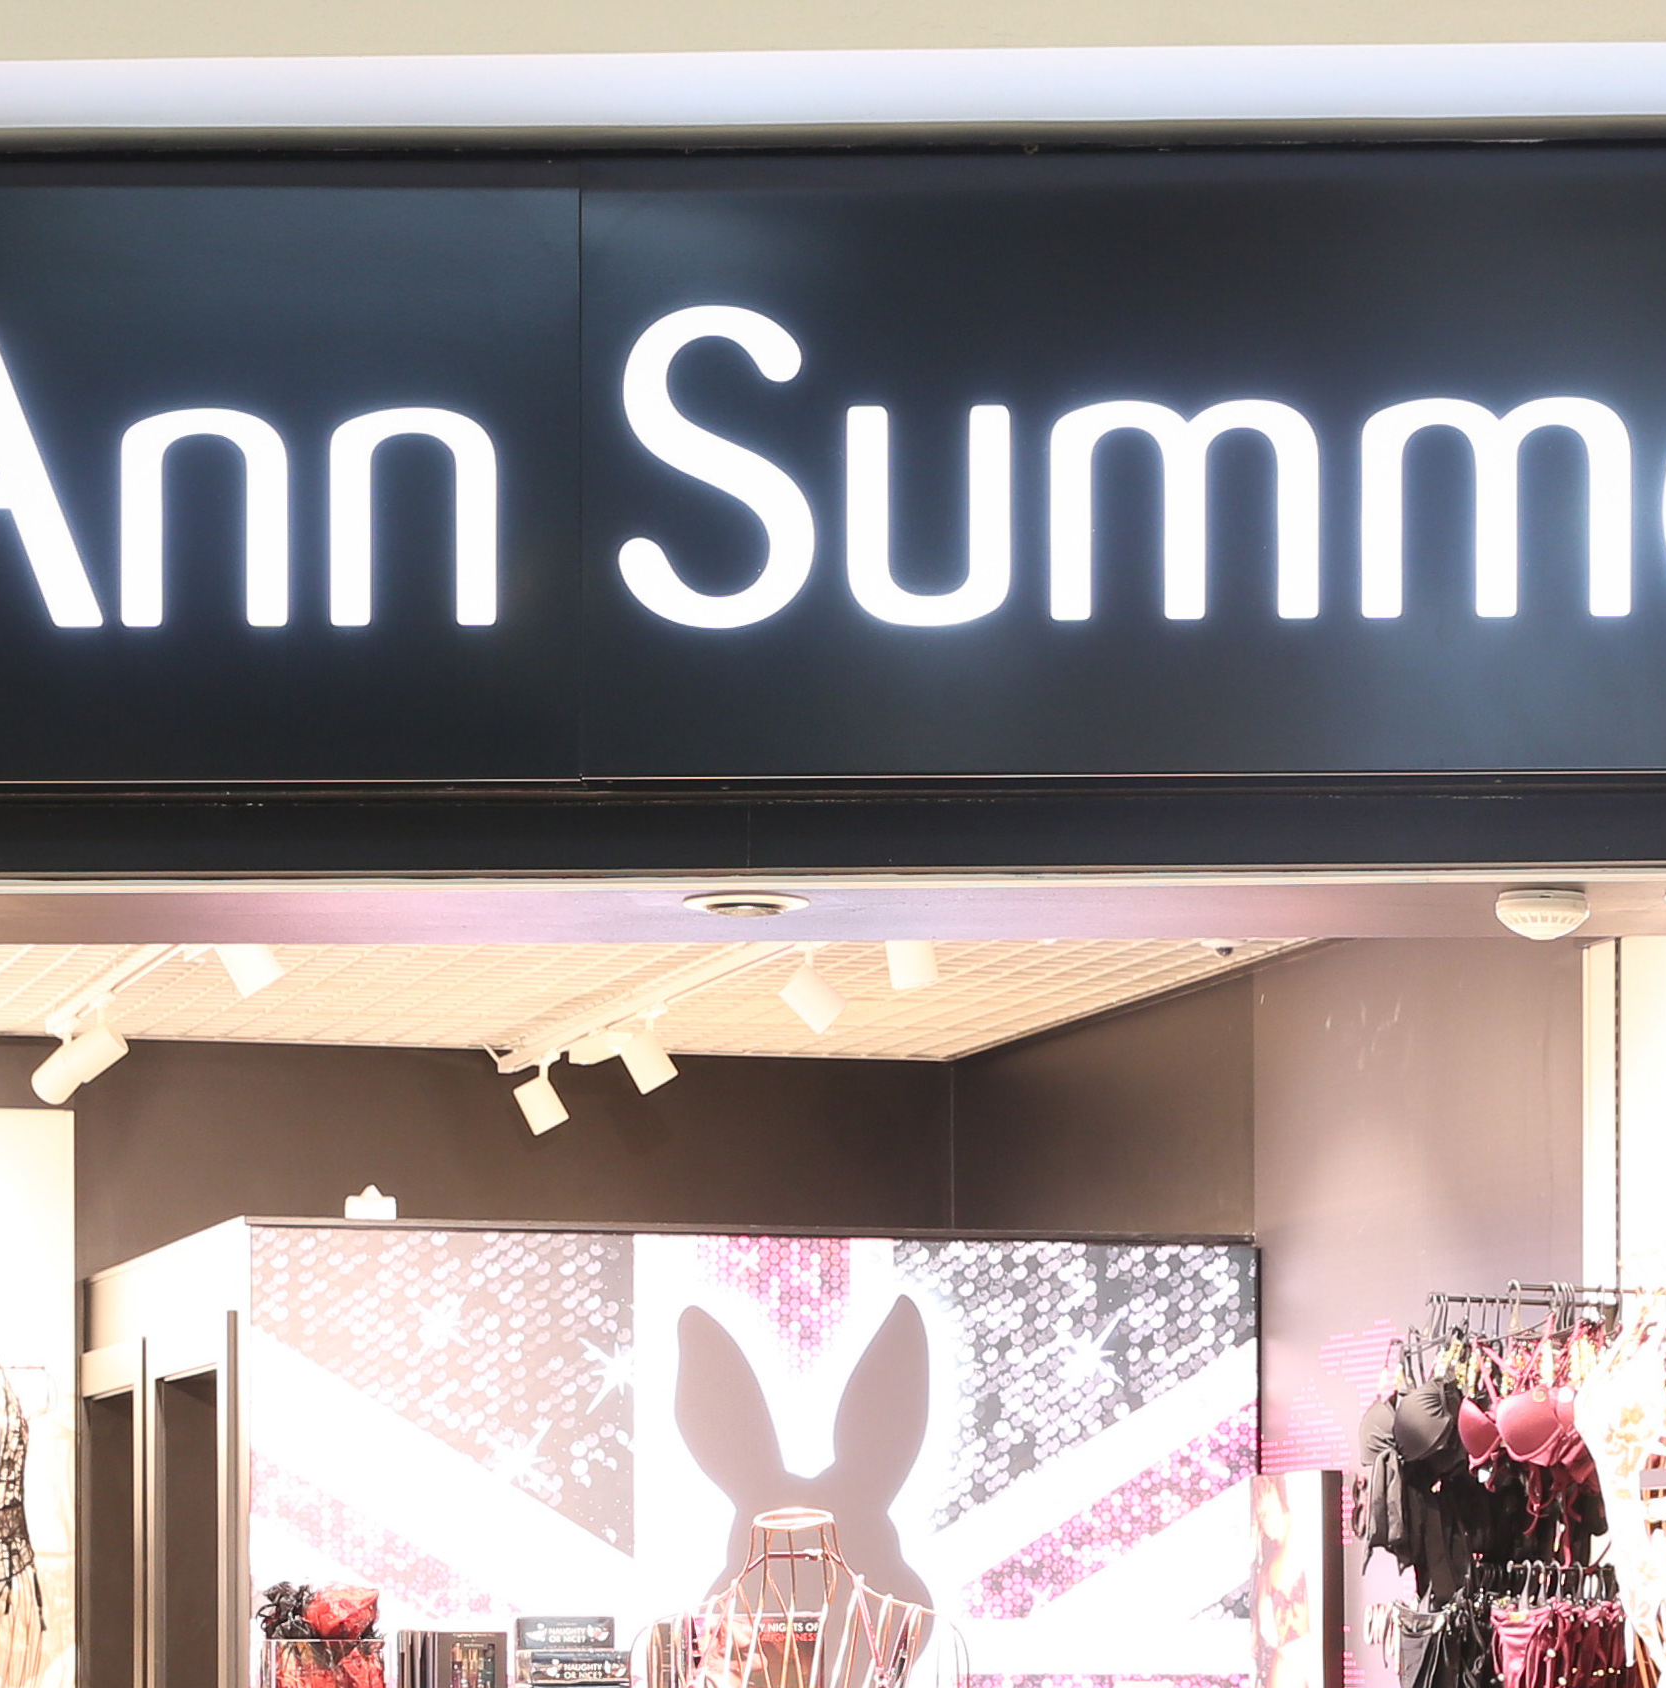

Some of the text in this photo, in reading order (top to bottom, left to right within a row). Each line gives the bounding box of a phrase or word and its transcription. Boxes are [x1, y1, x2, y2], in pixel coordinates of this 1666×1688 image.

[549, 1627, 586, 1635] NAUGHTY
[767, 1622, 804, 1632] NIGTS
[563, 1663, 602, 1671] NAUGHTY
[563, 1671, 602, 1679] OR NICE?
